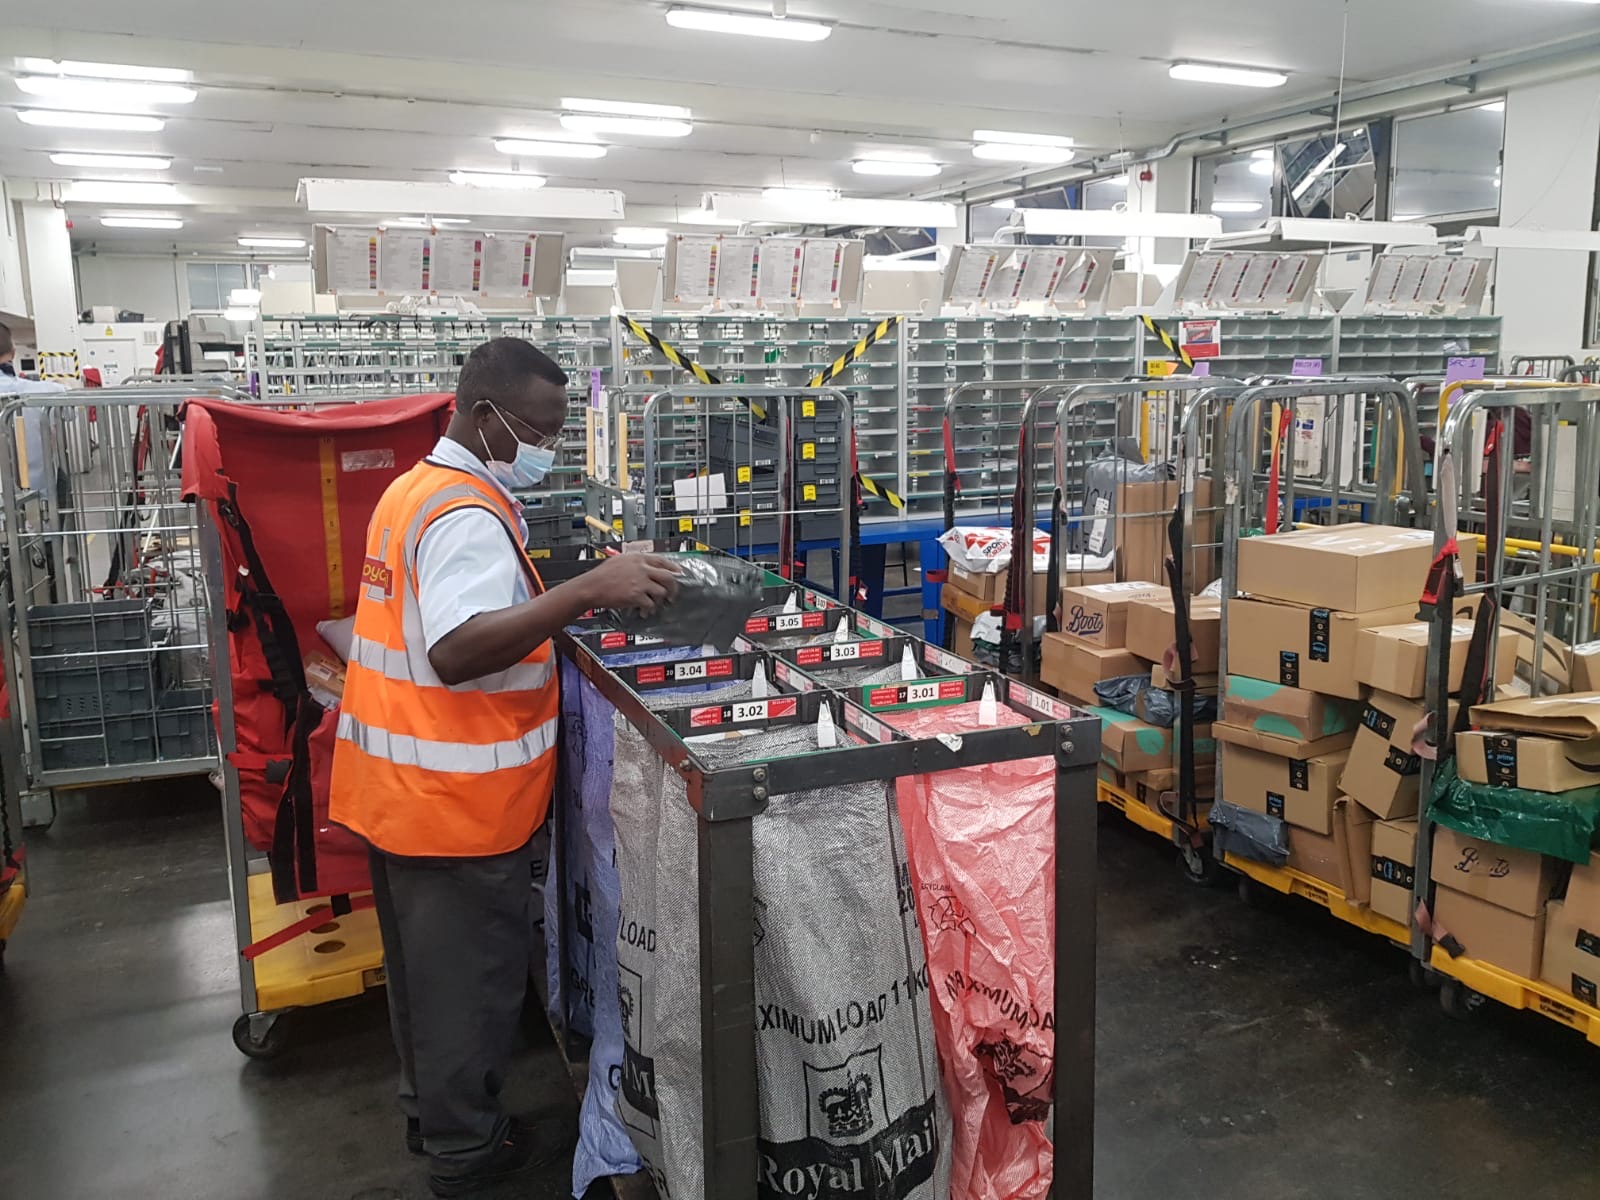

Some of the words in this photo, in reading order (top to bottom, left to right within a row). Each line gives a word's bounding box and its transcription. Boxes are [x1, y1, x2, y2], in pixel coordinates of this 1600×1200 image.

[780, 617, 799, 628] 3.05
[1066, 605, 1104, 635] Boots
[835, 646, 856, 658] 3.03
[679, 665, 703, 677] 3.04
[911, 687, 936, 700] 3.01
[737, 705, 764, 718] 3.02
[620, 914, 658, 954] LOAD
[754, 1003, 838, 1045] XIMUM
[836, 992, 887, 1035] LOAD
[756, 1152, 865, 1200] Royal
[873, 1115, 938, 1189] Mail
